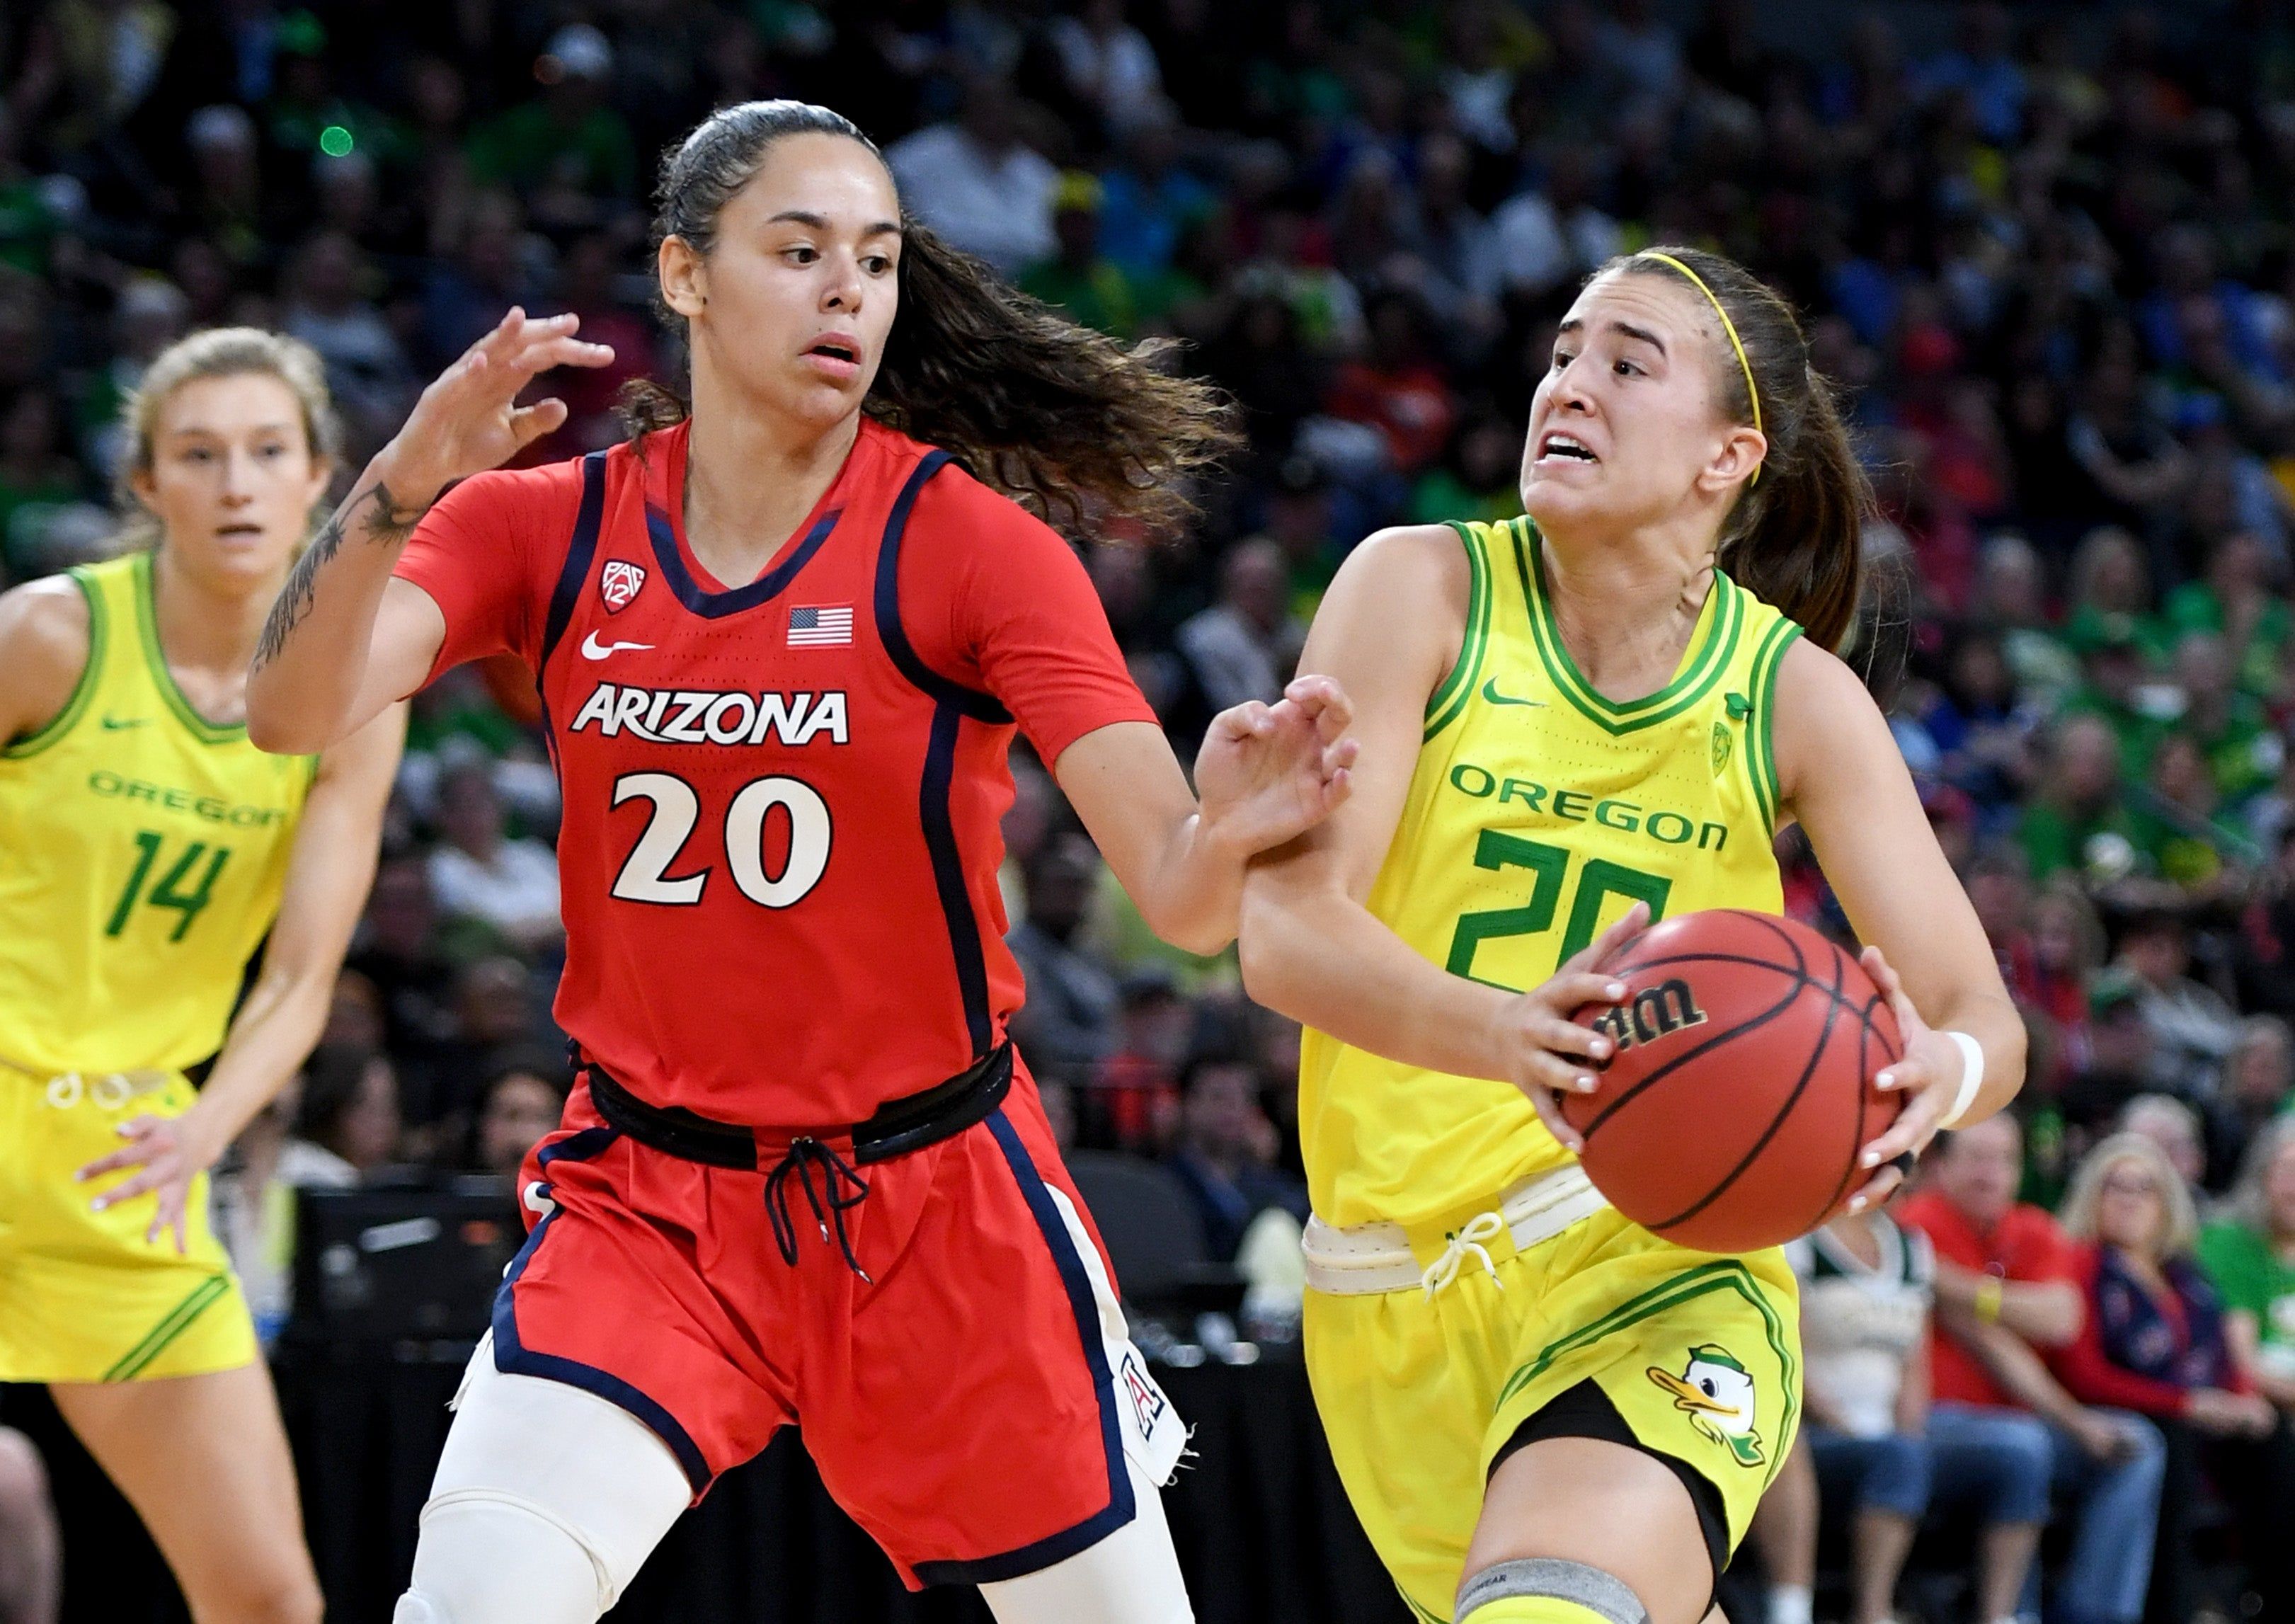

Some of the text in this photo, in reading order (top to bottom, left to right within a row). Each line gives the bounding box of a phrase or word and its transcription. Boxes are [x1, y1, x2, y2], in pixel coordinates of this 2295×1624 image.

[602, 561, 646, 598] PAC
[605, 582, 626, 605] 12
[569, 680, 850, 747] ARIZONA
[88, 770, 283, 827] OREGON
[609, 770, 834, 909] 20
[1450, 764, 1729, 852] OREGON
[106, 831, 230, 942] 14
[1446, 828, 1673, 994] 20
[1121, 1351, 1165, 1442] A
